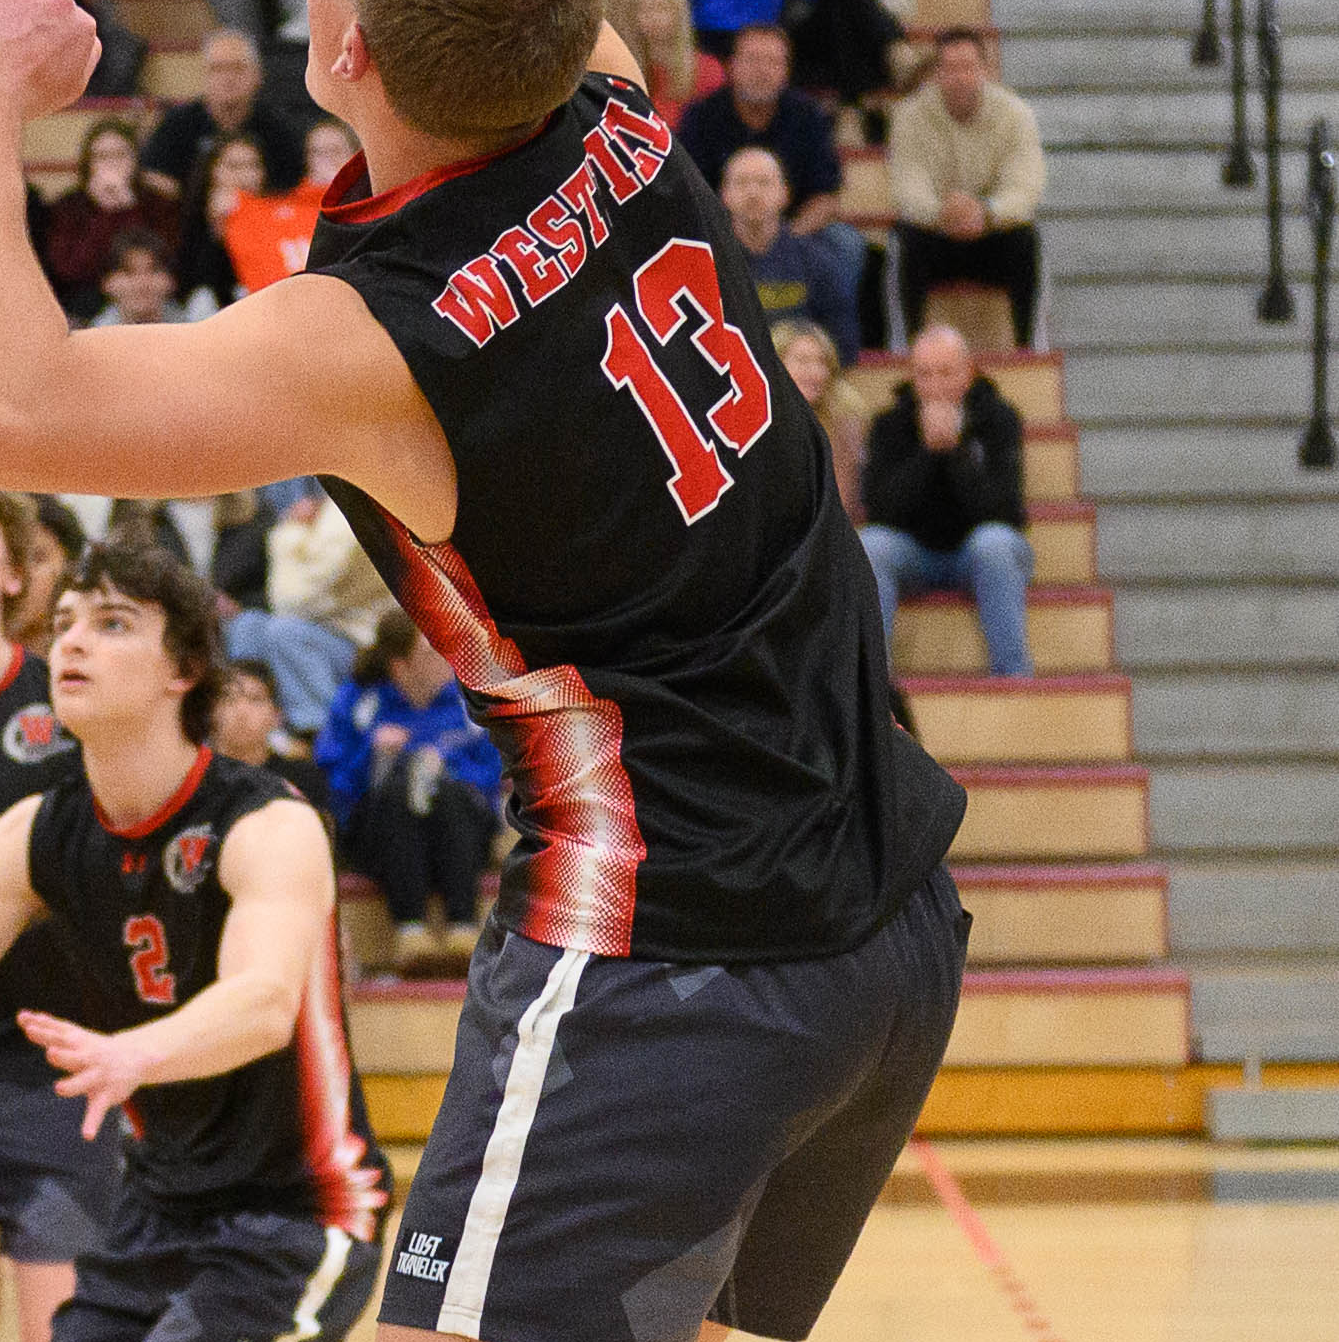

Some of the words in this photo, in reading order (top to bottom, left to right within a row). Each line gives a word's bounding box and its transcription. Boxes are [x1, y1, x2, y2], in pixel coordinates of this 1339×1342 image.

[601, 237, 772, 525] 13
[124, 916, 175, 1003] 2
[396, 1251, 450, 1283] TRAVELER
[408, 1231, 443, 1258] LOST
